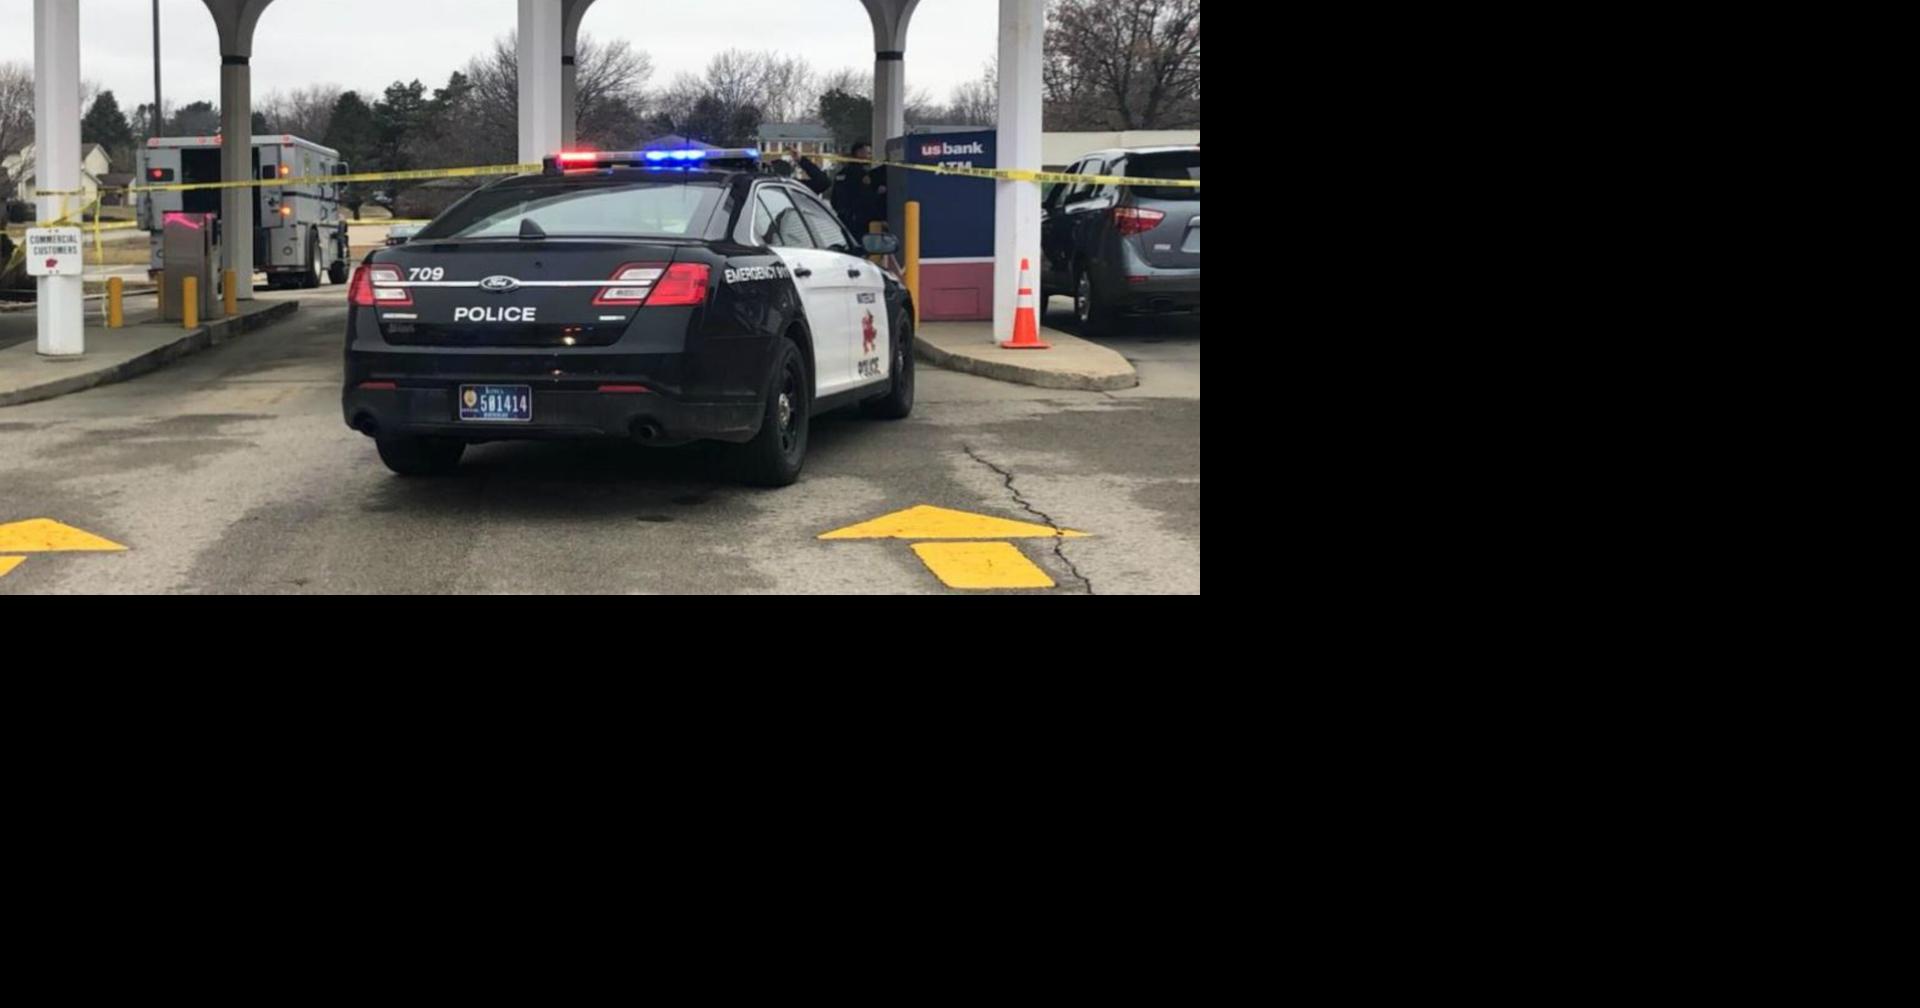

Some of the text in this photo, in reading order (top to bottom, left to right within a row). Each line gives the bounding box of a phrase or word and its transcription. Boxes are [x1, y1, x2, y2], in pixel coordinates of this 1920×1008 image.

[30, 235, 78, 244] COMMERCIAL
[33, 245, 78, 255] CUSTOMERS
[409, 267, 444, 281] 709
[724, 266, 776, 284] EMERGENCY
[454, 307, 536, 322] POLICE
[480, 395, 527, 412] 501414
